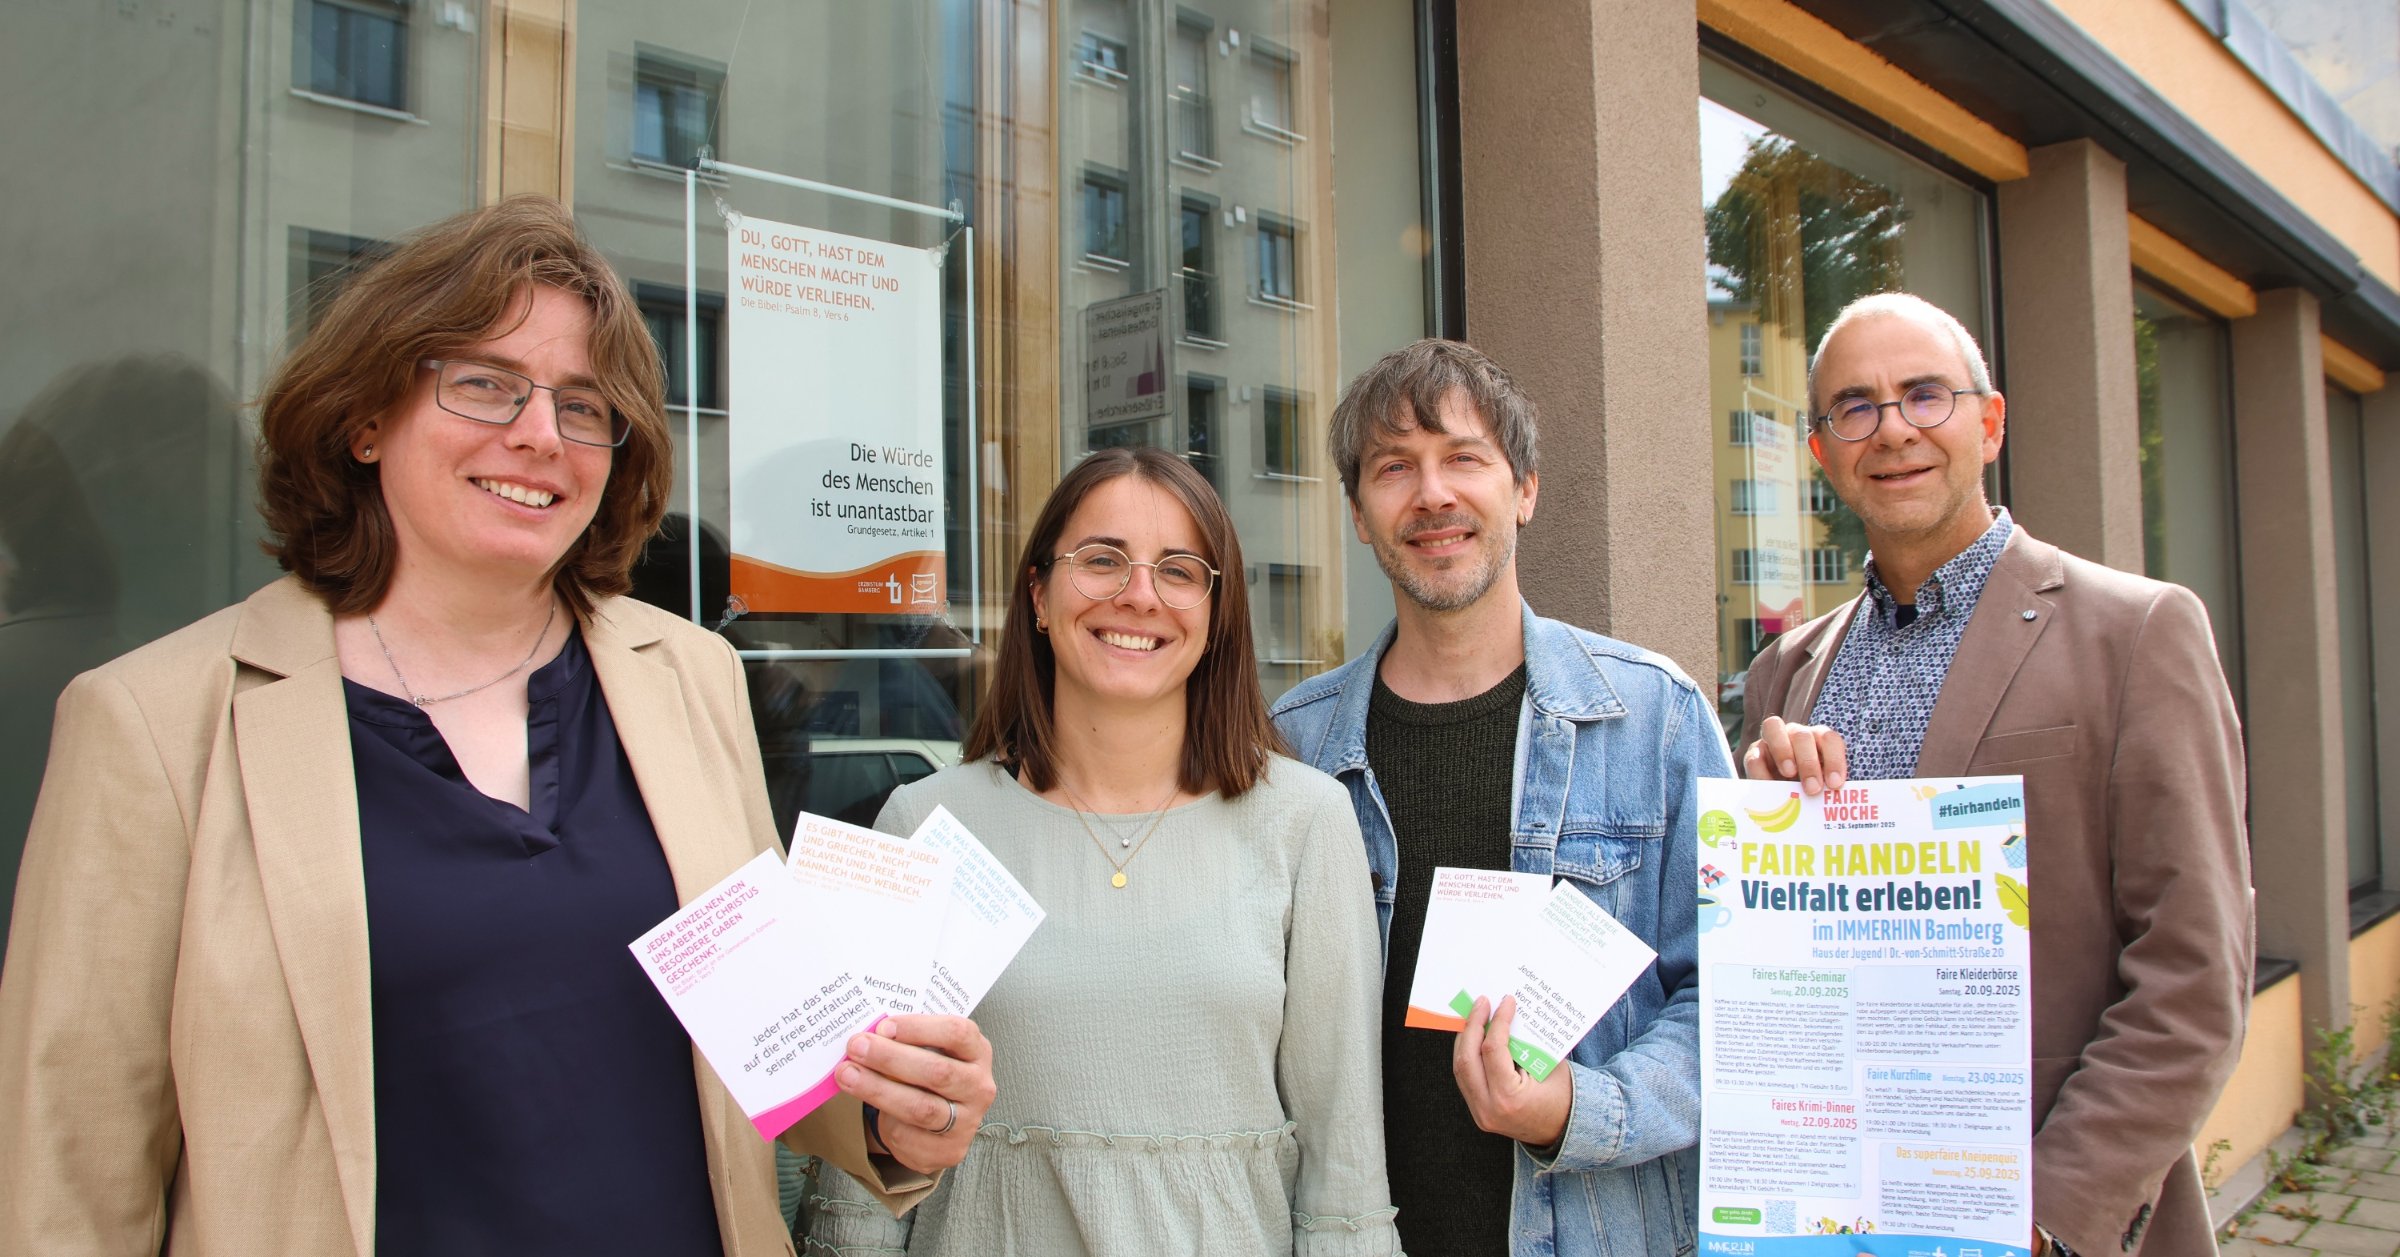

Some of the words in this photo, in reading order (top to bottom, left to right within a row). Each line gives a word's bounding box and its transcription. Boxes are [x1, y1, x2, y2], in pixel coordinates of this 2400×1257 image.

[741, 229, 766, 250] DU,
[771, 235, 813, 258] GOTT,
[818, 243, 853, 262] HAST
[857, 250, 885, 268] DEM
[741, 252, 816, 279] MENSCHEN
[821, 266, 868, 288] MACHT
[872, 275, 899, 293] UND
[741, 273, 792, 298] WÜRDE
[797, 285, 875, 311] VERLIEHEN.
[741, 297, 756, 309] Die
[758, 300, 782, 312] Bibel:
[786, 304, 811, 317] Psalm
[813, 308, 821, 319] 8,
[824, 310, 842, 321] Vers
[844, 313, 849, 322] 6
[851, 443, 877, 463] Die
[882, 446, 933, 468] Würde
[822, 469, 850, 490] des
[856, 472, 934, 496] Menschen
[811, 498, 831, 518] ist
[837, 499, 934, 524] unantastbar
[847, 525, 899, 539] Grundgesetz,
[902, 527, 928, 538] Artikel
[931, 529, 934, 538] 1
[1824, 789, 1869, 805] FAIRE
[1939, 796, 2021, 818] #fairhandeln
[1824, 805, 1879, 822] WOCHE
[1848, 822, 1879, 830] September
[802, 834, 825, 848] UND
[826, 840, 879, 862] GRIECHEN,
[881, 854, 912, 870] NICHT
[805, 822, 818, 834] ES
[820, 826, 844, 840] GIBT
[845, 833, 876, 848] NICHT
[877, 841, 906, 856] MEHR
[906, 849, 940, 866] JUDEN
[930, 826, 953, 850] ABER
[962, 857, 978, 874] DIR
[799, 846, 843, 865] SKLAVEN
[845, 858, 867, 871] UND
[868, 864, 900, 880] FREIE,
[902, 873, 932, 888] NICHT
[1742, 842, 1815, 877] FAIR
[1824, 840, 1981, 876] HANDELN
[850, 872, 872, 885] UND
[872, 878, 924, 899] WEIBLICH.
[951, 831, 971, 852] WAS
[968, 848, 988, 868] DEIN
[985, 866, 1006, 887] HERZ
[1003, 885, 1020, 902] DIR
[1014, 899, 1039, 923] SAGT!
[1438, 881, 1476, 889] MENSCHEN
[954, 865, 975, 886] DICH
[973, 884, 990, 901] VOR
[987, 899, 1009, 922] GOTT
[1741, 879, 1849, 912] Vielfalt
[1856, 879, 1982, 912] erleben!
[643, 928, 677, 955] JEDEM
[675, 894, 726, 933] EINZELNEN
[724, 879, 747, 899] VON
[650, 946, 673, 965] UNS
[670, 929, 697, 951] ABER
[695, 916, 716, 934] HAT
[714, 885, 760, 921] CHRISTUS
[1812, 919, 1833, 941] im
[1837, 918, 1921, 942] IMMERHIN
[1926, 917, 2004, 944] Bamberg
[658, 934, 712, 975] BESONDERE
[710, 911, 744, 939] GABEN
[1812, 947, 1833, 958] Haus
[1835, 947, 1850, 958] der
[1851, 947, 1882, 961] Jugend
[1890, 946, 1991, 959] Dr.-von-Schmitt-Straße
[1992, 947, 2004, 958] 20
[665, 942, 722, 986] GESCHENKT.
[1752, 968, 1777, 980] Faires
[1780, 969, 1846, 982] Kaffee-Seminar
[1936, 968, 1958, 980] Faire
[1960, 968, 2018, 980] Kleiderbörse
[863, 974, 918, 998] Menschen
[928, 974, 968, 1015] Gewissens
[935, 965, 976, 1006] Glaubens,
[1518, 964, 1540, 983] Jeder
[1537, 979, 1553, 994] hat
[1550, 990, 1566, 1005] das
[1563, 1001, 1590, 1024] Recht,
[1795, 986, 1848, 998] 20.09.2025
[1965, 985, 2020, 997] 20.09.2025
[750, 1020, 783, 1048] Jeder
[780, 1006, 802, 1026] hat
[800, 992, 822, 1012] das
[820, 970, 853, 997] Recht
[889, 997, 915, 1014] dem
[1512, 989, 1536, 1010] Wort,
[1533, 1006, 1560, 1029] Schrift
[1557, 1026, 1574, 1041] und
[1515, 1006, 1532, 1021] frei
[1529, 1018, 1541, 1029] zu
[1522, 982, 1545, 1002] seine
[1540, 998, 1574, 1027] Meinung
[1571, 1022, 1582, 1032] in
[741, 1052, 764, 1073] auf
[760, 1040, 781, 1060] die
[778, 1021, 808, 1046] freie
[805, 983, 863, 1028] Entfaltung
[764, 1048, 799, 1077] seiner
[796, 996, 872, 1053] Persönlichkeit
[1867, 1068, 1888, 1080] Faire
[1890, 1069, 1932, 1081] Kurzfilme
[1968, 1072, 2024, 1085] 23.09.2025
[1772, 1099, 1796, 1111] Faires
[1799, 1100, 1856, 1114] Krimi-Dinner
[1803, 1117, 1857, 1130] 22.09.2025
[1896, 1146, 1911, 1159] Das
[1914, 1148, 1959, 1161] superfaire
[1962, 1150, 2018, 1165] Kneipenquiz
[1964, 1167, 2020, 1181] 25.09.2025
